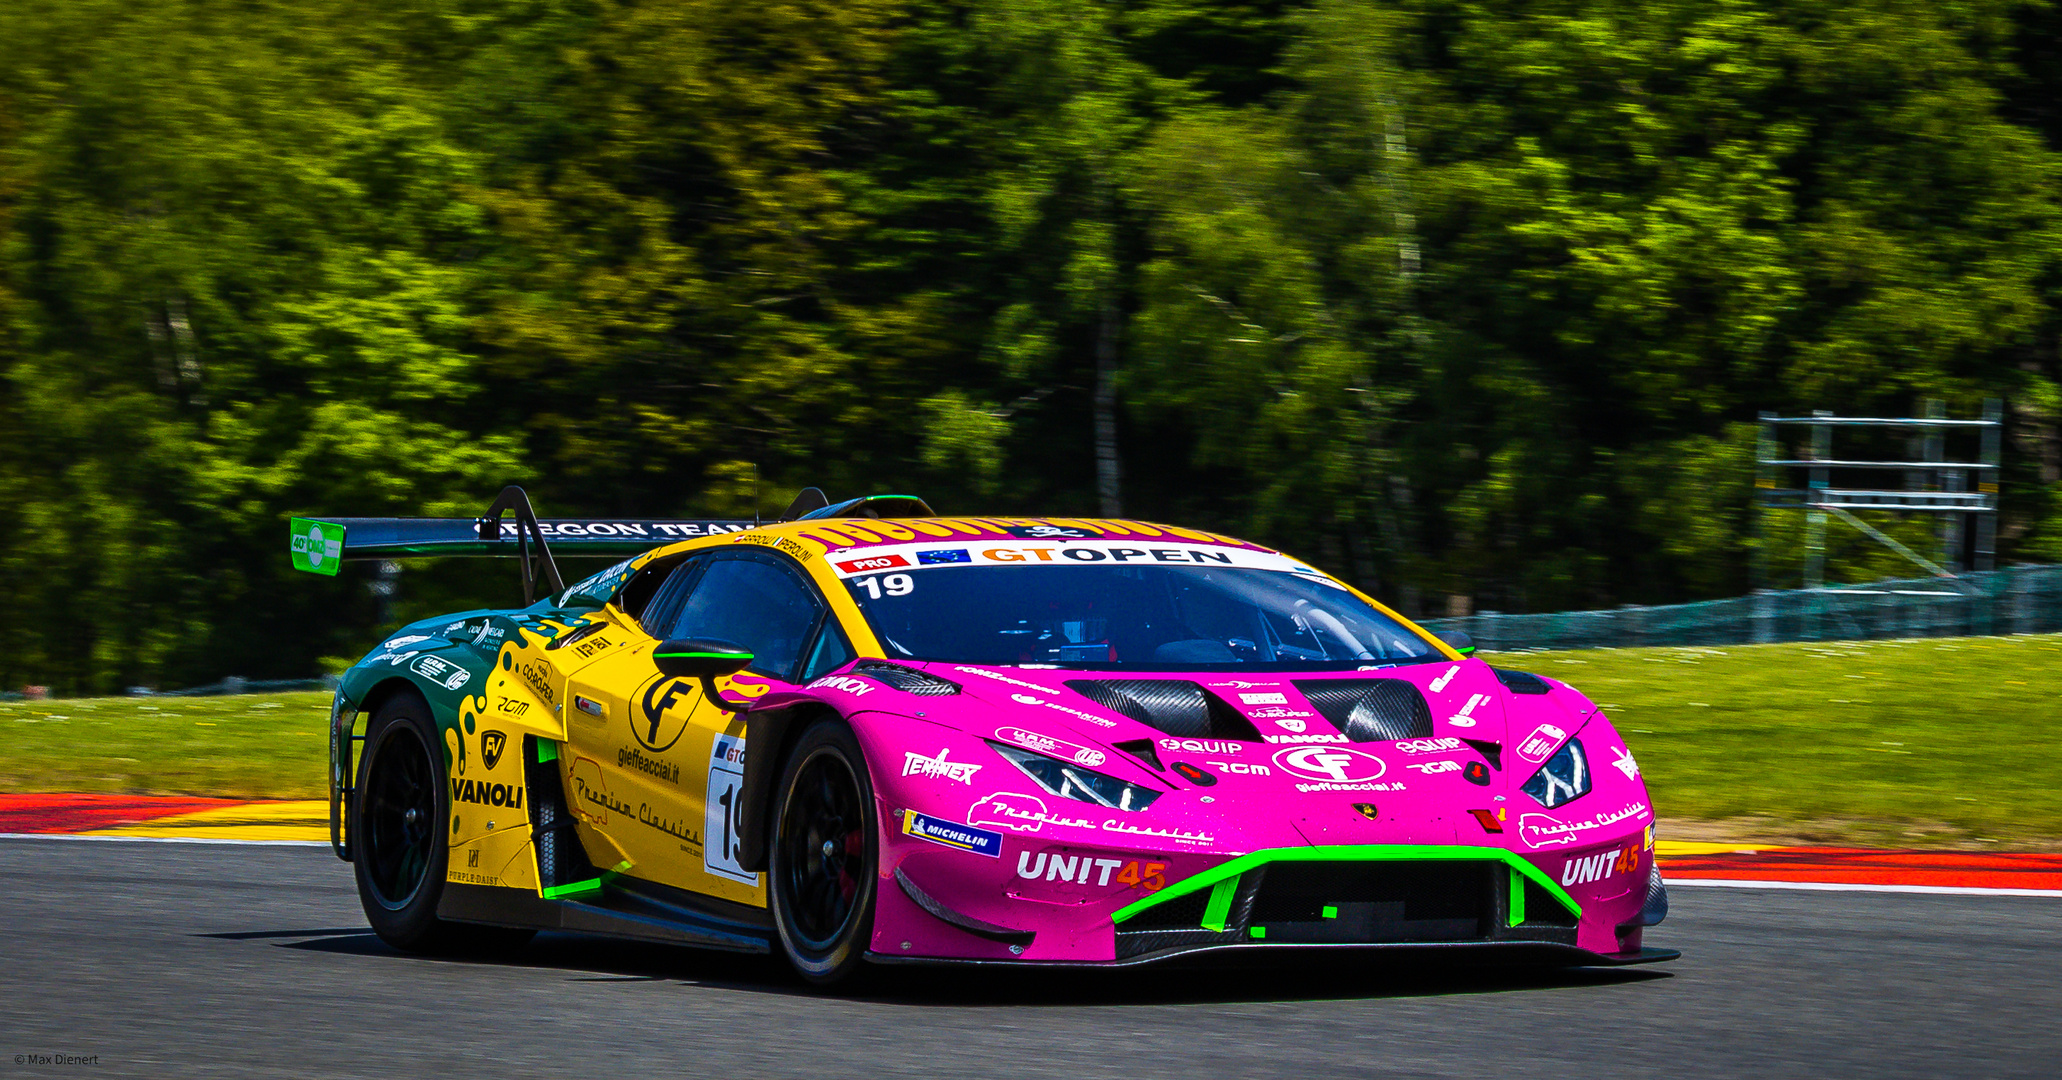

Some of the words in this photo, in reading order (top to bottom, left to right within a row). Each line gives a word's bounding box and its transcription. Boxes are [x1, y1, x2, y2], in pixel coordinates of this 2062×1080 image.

[474, 523, 649, 536] REGON
[853, 558, 893, 570] PRO
[856, 573, 914, 600] 19
[618, 745, 680, 785] gieffeacciai.it
[452, 778, 523, 809] VANOLI
[575, 776, 636, 820] Premium
[639, 803, 703, 847] Classics
[992, 802, 1096, 829] Premium
[1102, 819, 1214, 842] Classics
[927, 824, 988, 847] MICHELIN
